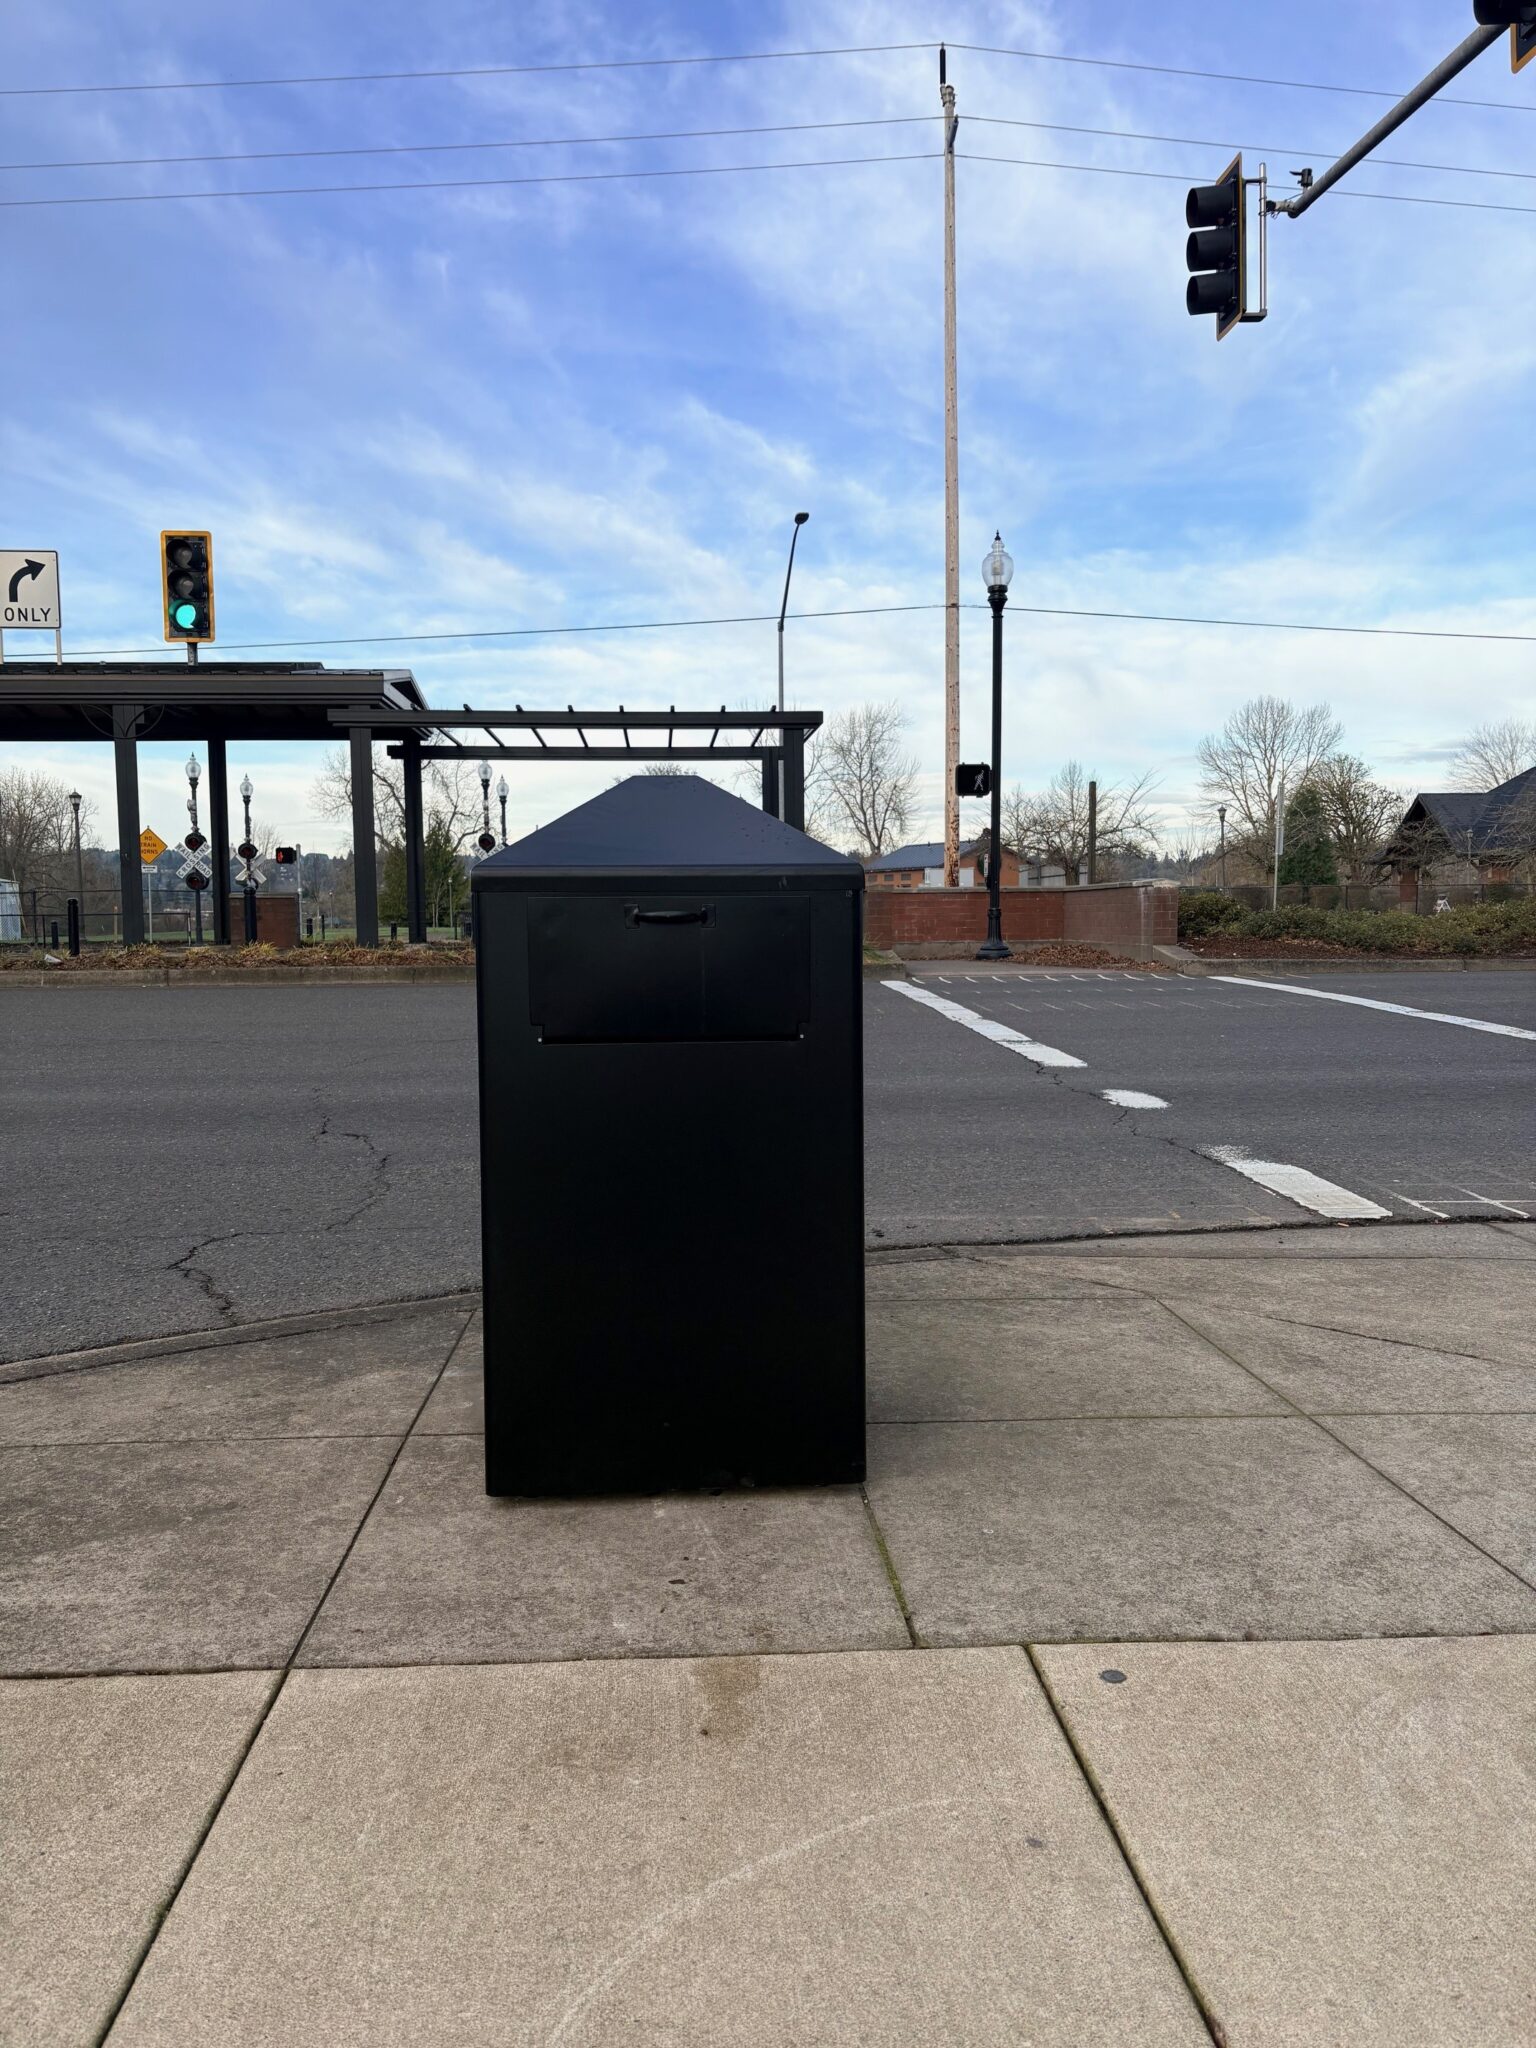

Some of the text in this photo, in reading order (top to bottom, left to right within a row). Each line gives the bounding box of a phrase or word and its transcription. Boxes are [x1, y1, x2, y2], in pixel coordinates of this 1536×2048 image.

[4, 607, 51, 622] ONLY
[178, 843, 210, 877] CROSSING
[194, 861, 211, 877] ROAD
